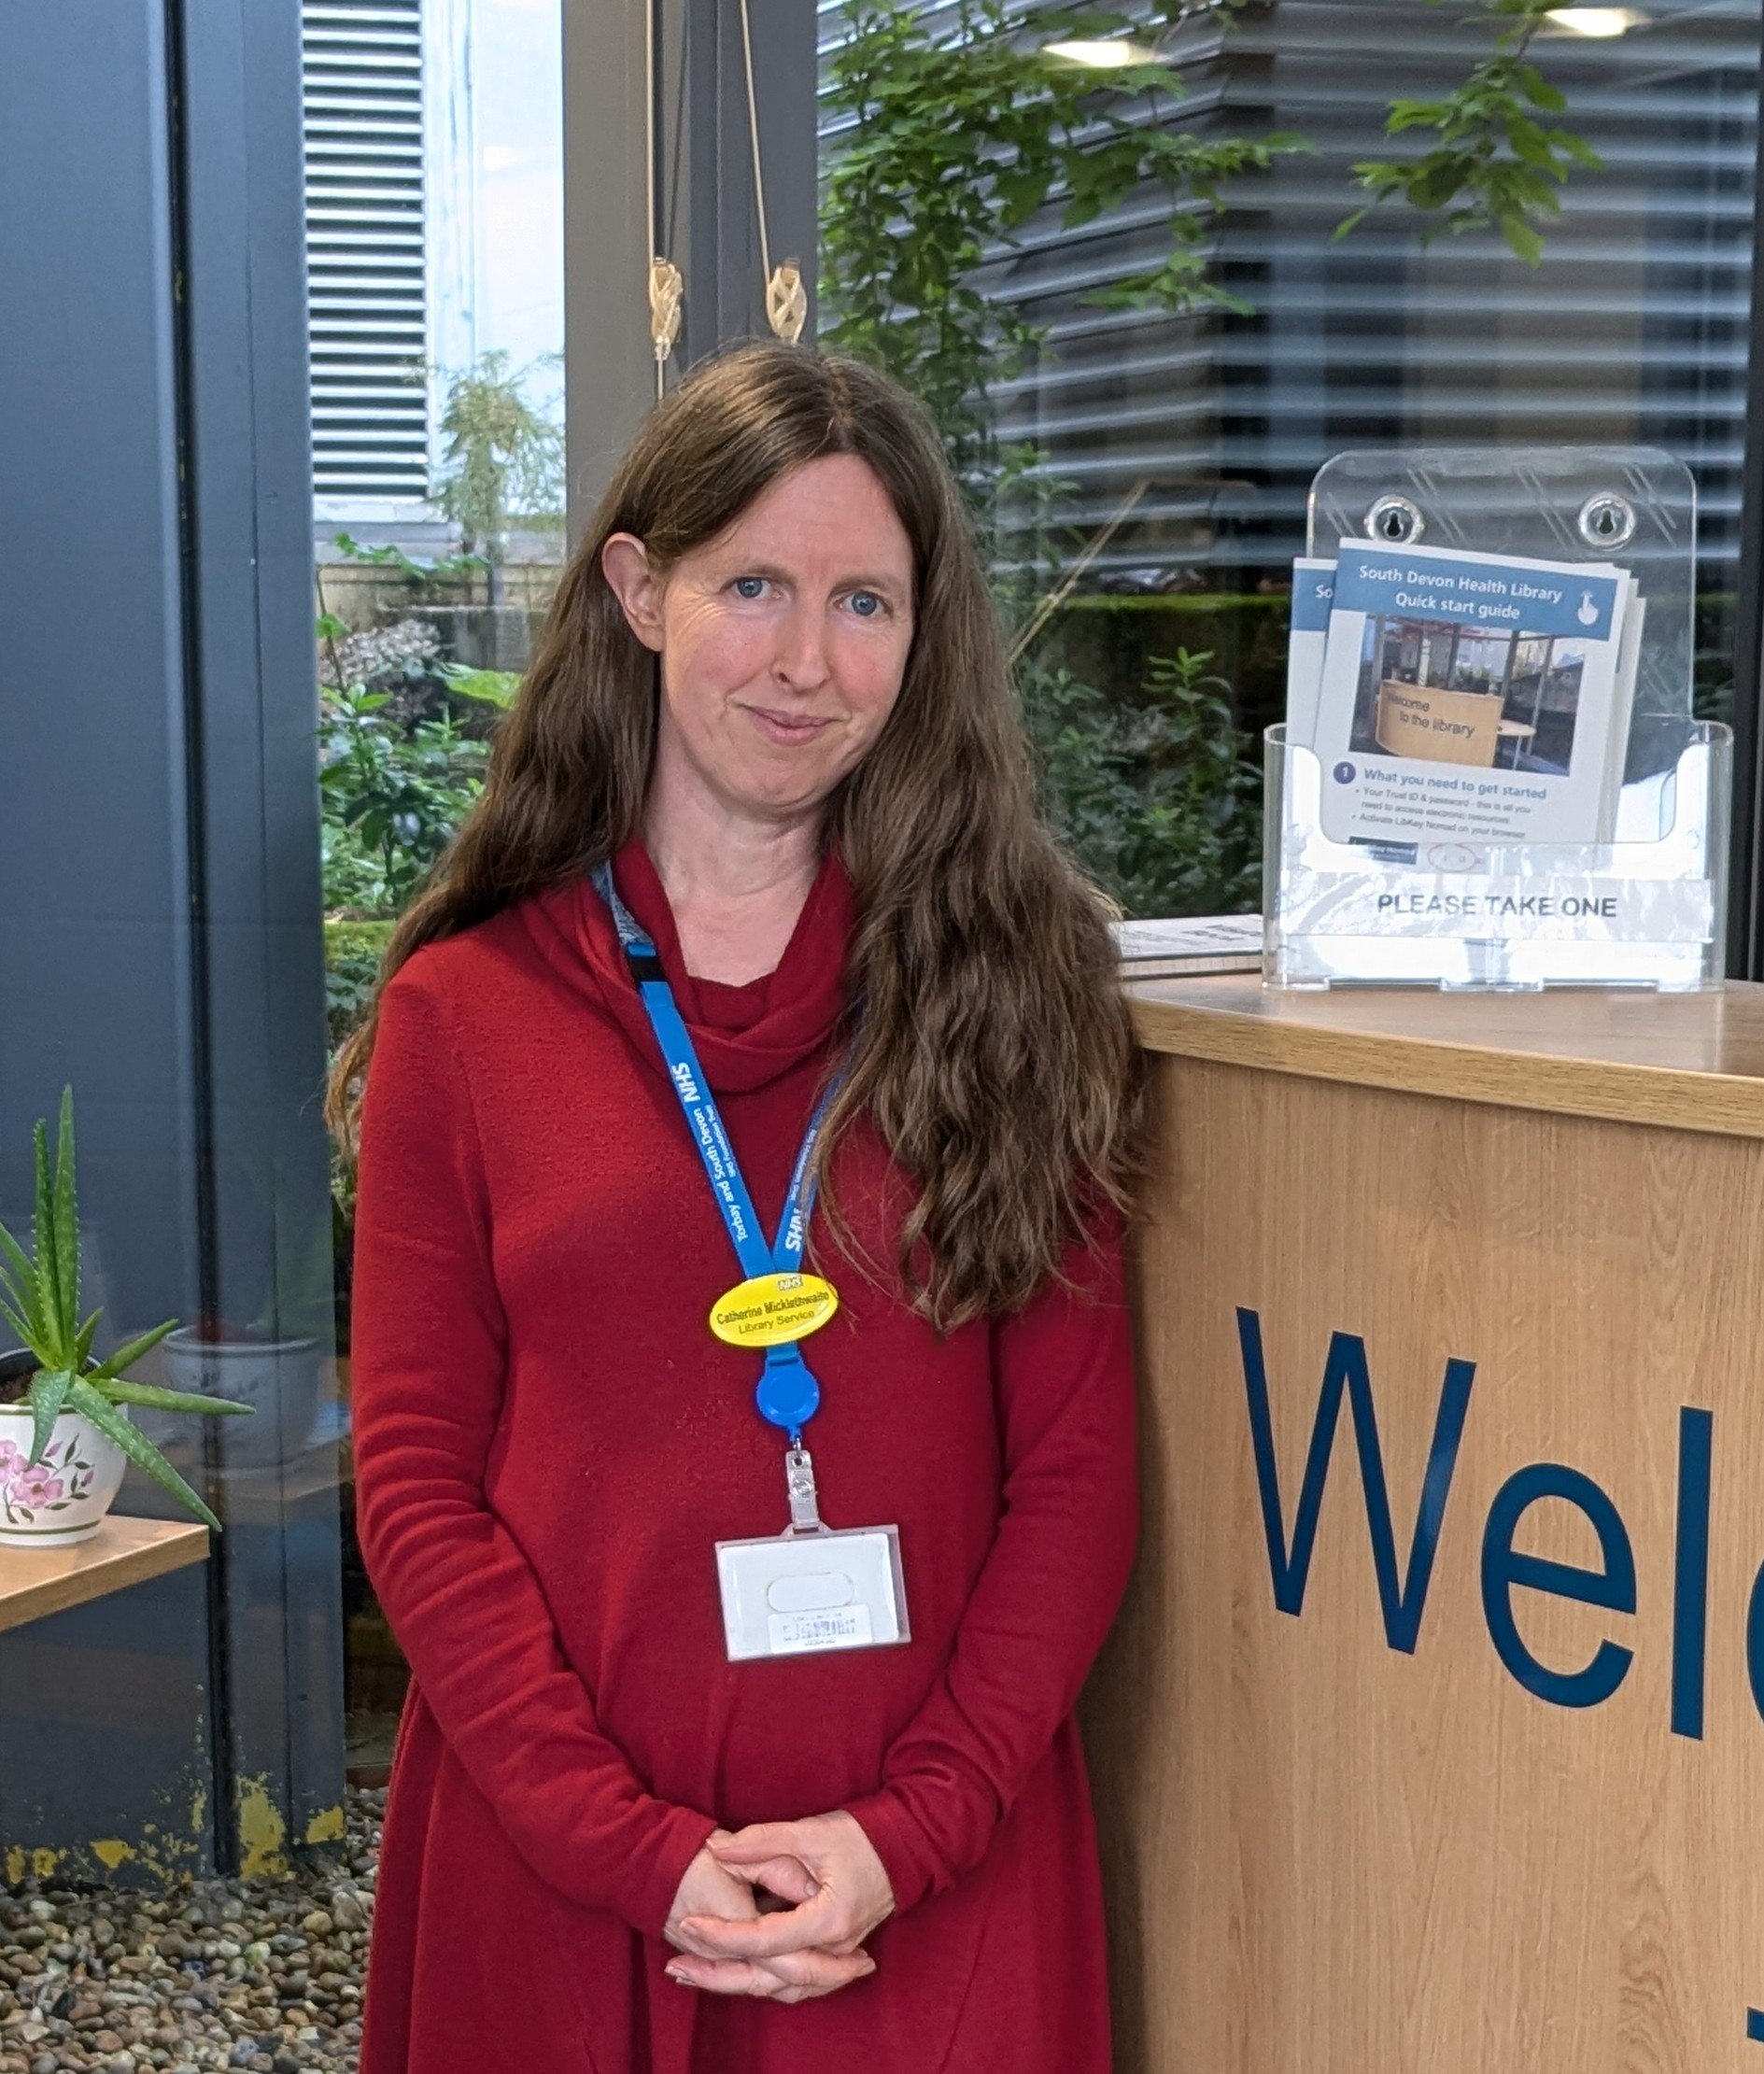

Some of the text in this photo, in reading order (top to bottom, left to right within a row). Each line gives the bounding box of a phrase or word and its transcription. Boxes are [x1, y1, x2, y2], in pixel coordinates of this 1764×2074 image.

[1360, 565, 1562, 603] South Devon Health Library
[1395, 592, 1520, 620] Quick start guide
[1411, 715, 1430, 727] the
[1432, 718, 1475, 739] library
[1363, 787, 1383, 797] Your
[1386, 790, 1406, 800] Trust
[1364, 769, 1547, 800] What you need to get started
[1377, 894, 1617, 918] PLEASE TAKE ONE
[671, 1062, 700, 1103] NHS
[693, 1108, 748, 1243] Torbay and South Devon
[778, 1277, 803, 1291] NHS
[716, 1306, 763, 1324] Catherine
[739, 1310, 815, 1334] Library Service
[1235, 1305, 1764, 1741] Wel
